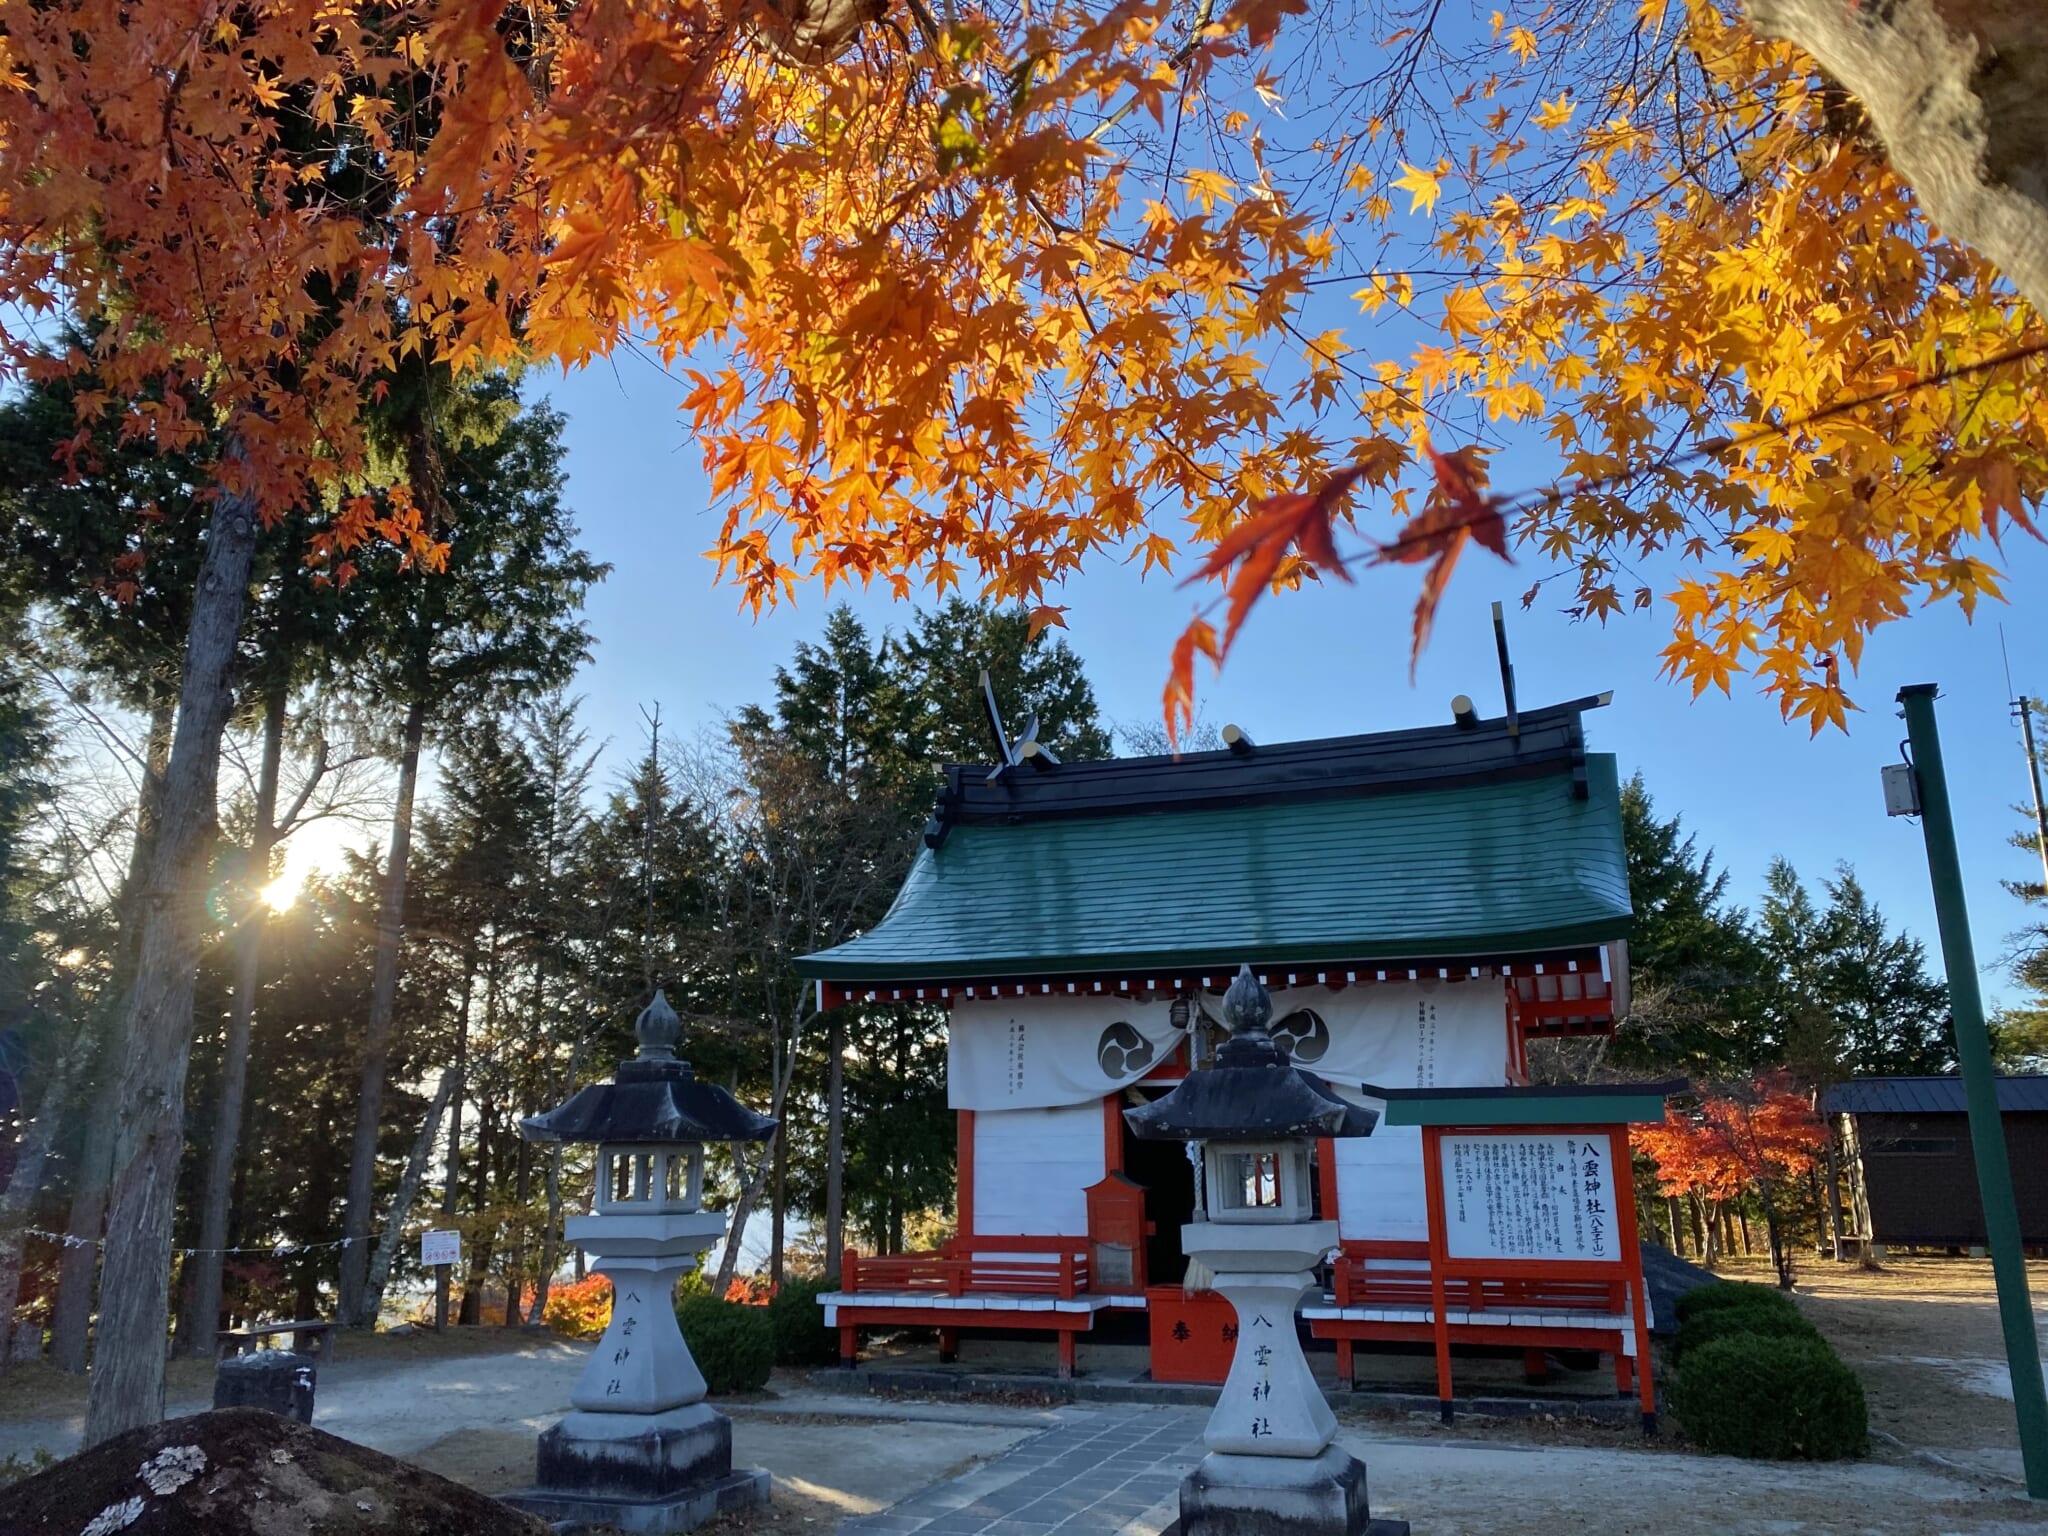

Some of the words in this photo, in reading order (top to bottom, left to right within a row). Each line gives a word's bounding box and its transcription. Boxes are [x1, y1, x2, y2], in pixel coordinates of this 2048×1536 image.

[606, 1291, 641, 1396] 八雲神社
[1252, 1314, 1273, 1438] 八雲神社
